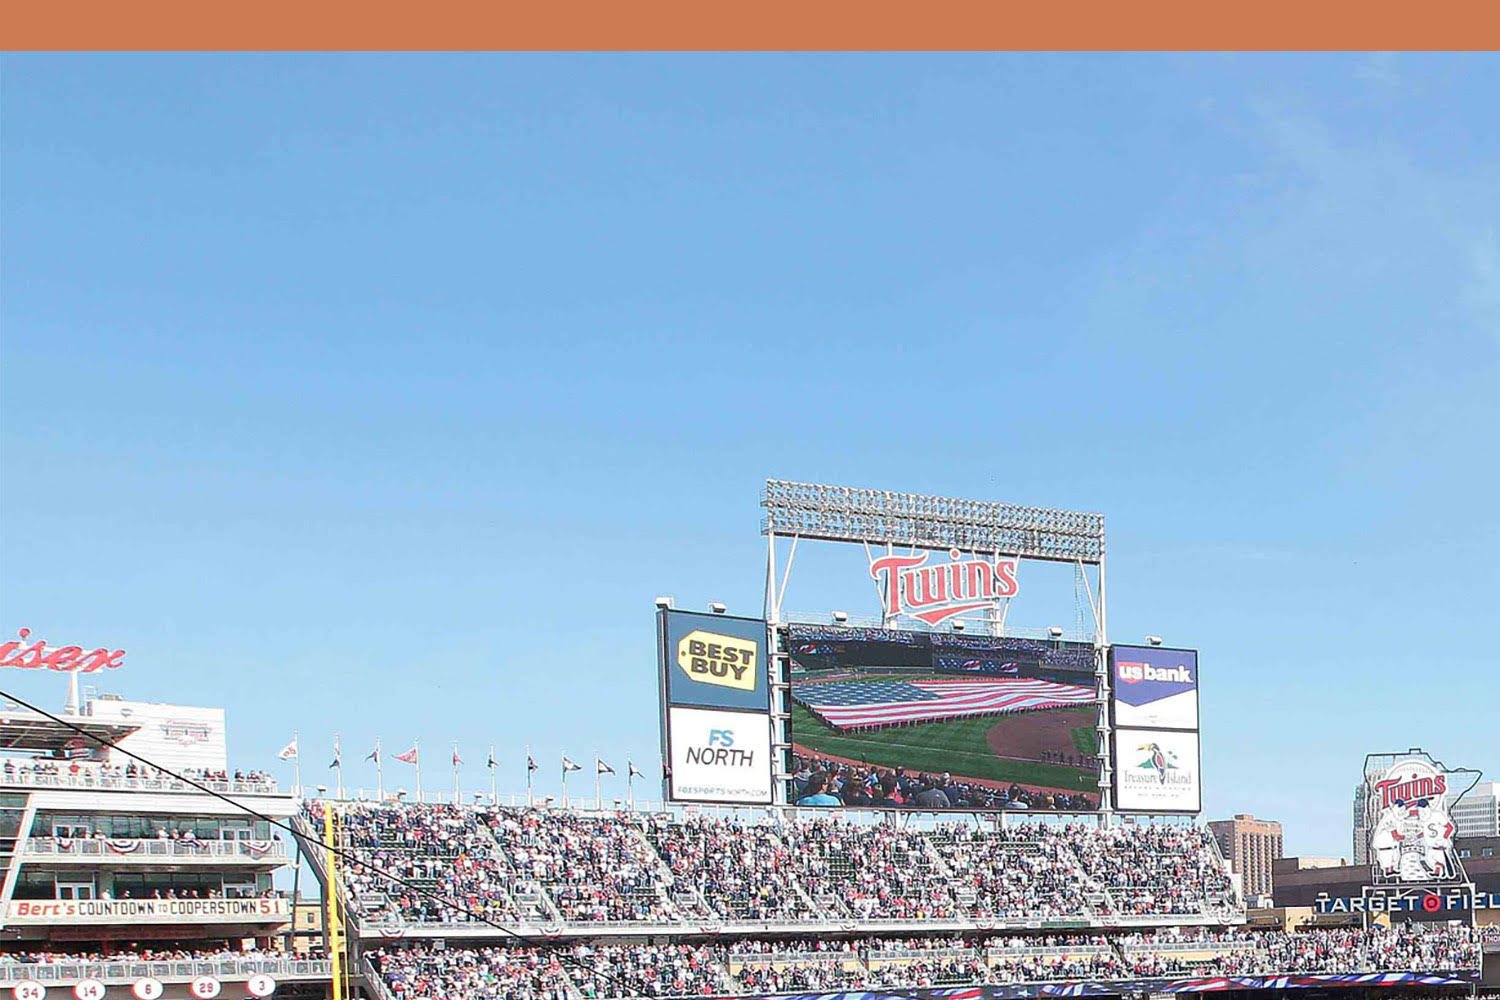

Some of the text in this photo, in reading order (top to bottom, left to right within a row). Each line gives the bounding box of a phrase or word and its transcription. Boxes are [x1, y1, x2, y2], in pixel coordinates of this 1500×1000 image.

[870, 548, 1019, 620] Twins
[689, 639, 755, 665] BEST
[690, 657, 748, 681] BUY
[708, 729, 735, 748] FS
[686, 747, 754, 767] NORTH
[1375, 773, 1447, 807] Twins
[17, 901, 75, 916] Bert's
[78, 901, 155, 916] COUNTDOWN
[170, 900, 257, 915] COOPERSTOWN
[260, 899, 281, 914] 51
[1315, 896, 1419, 913] TARGET
[22, 986, 39, 999] 34
[83, 985, 97, 998] 14
[258, 979, 266, 991] 3
